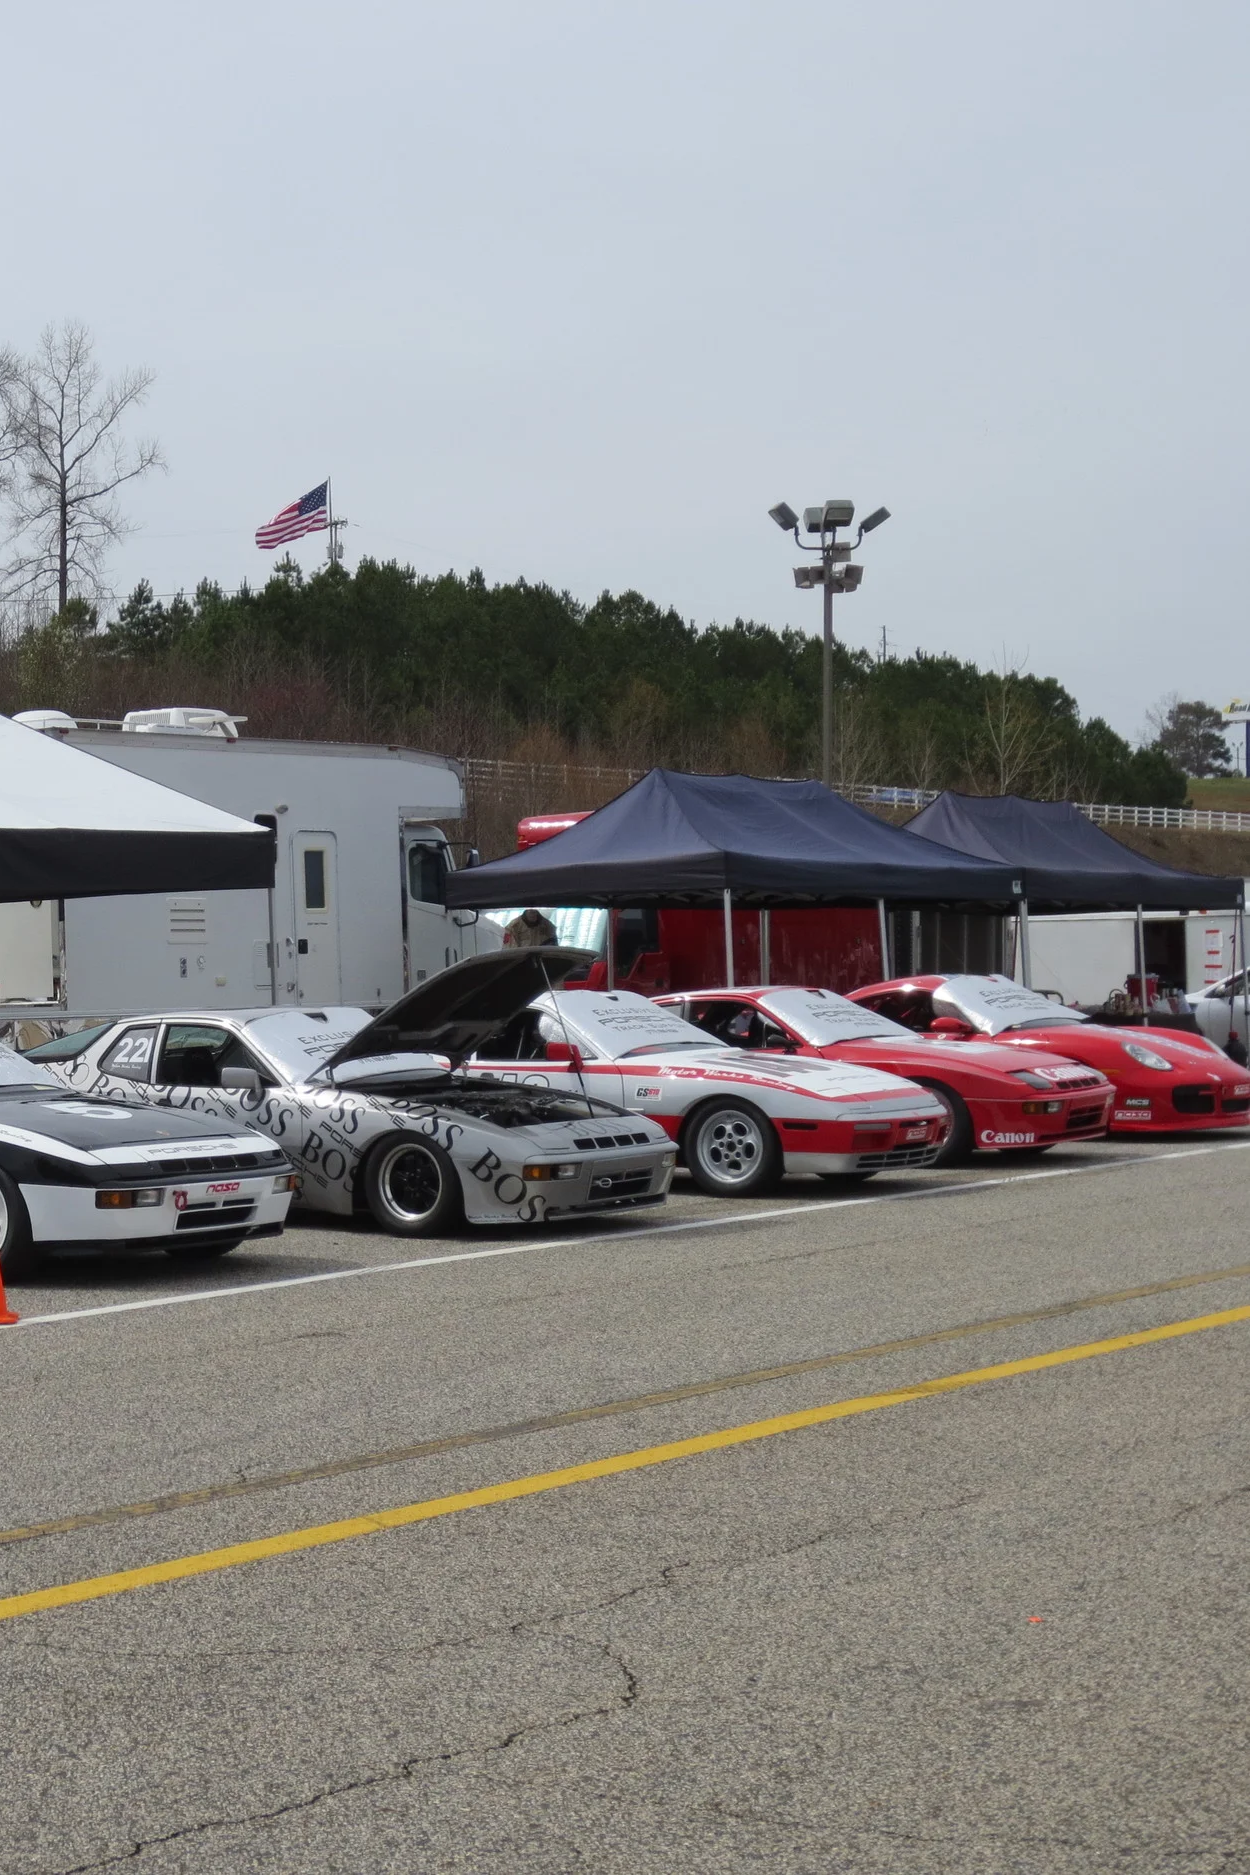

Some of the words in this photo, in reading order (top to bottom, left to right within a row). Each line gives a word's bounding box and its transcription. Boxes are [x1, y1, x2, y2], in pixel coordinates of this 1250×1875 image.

[297, 1030, 357, 1045] EXCLUSI
[657, 1064, 697, 1077] Motor
[1034, 1066, 1095, 1081] Canon
[980, 1129, 1035, 1144] Canon
[148, 1142, 238, 1155] PORSCHE
[206, 1182, 240, 1193] nasa
